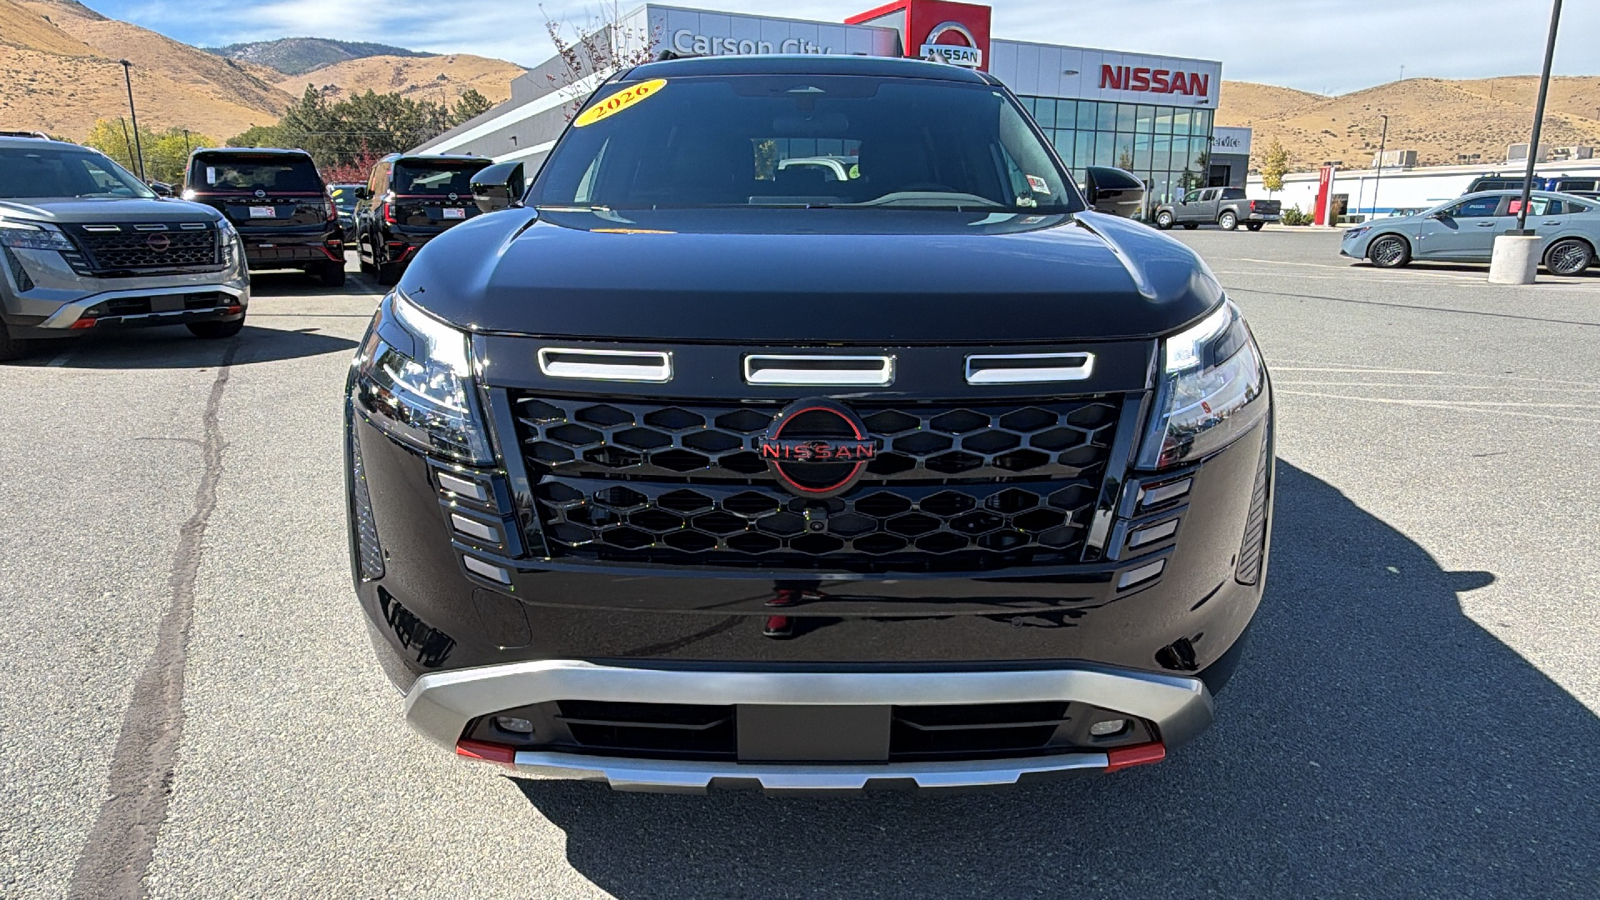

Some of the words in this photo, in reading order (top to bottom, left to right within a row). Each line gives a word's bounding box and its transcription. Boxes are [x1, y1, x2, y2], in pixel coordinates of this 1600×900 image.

[673, 29, 774, 55] Carson
[1101, 64, 1209, 97] NISSAN
[593, 86, 649, 118] 2026
[762, 444, 873, 459] NISSAN
